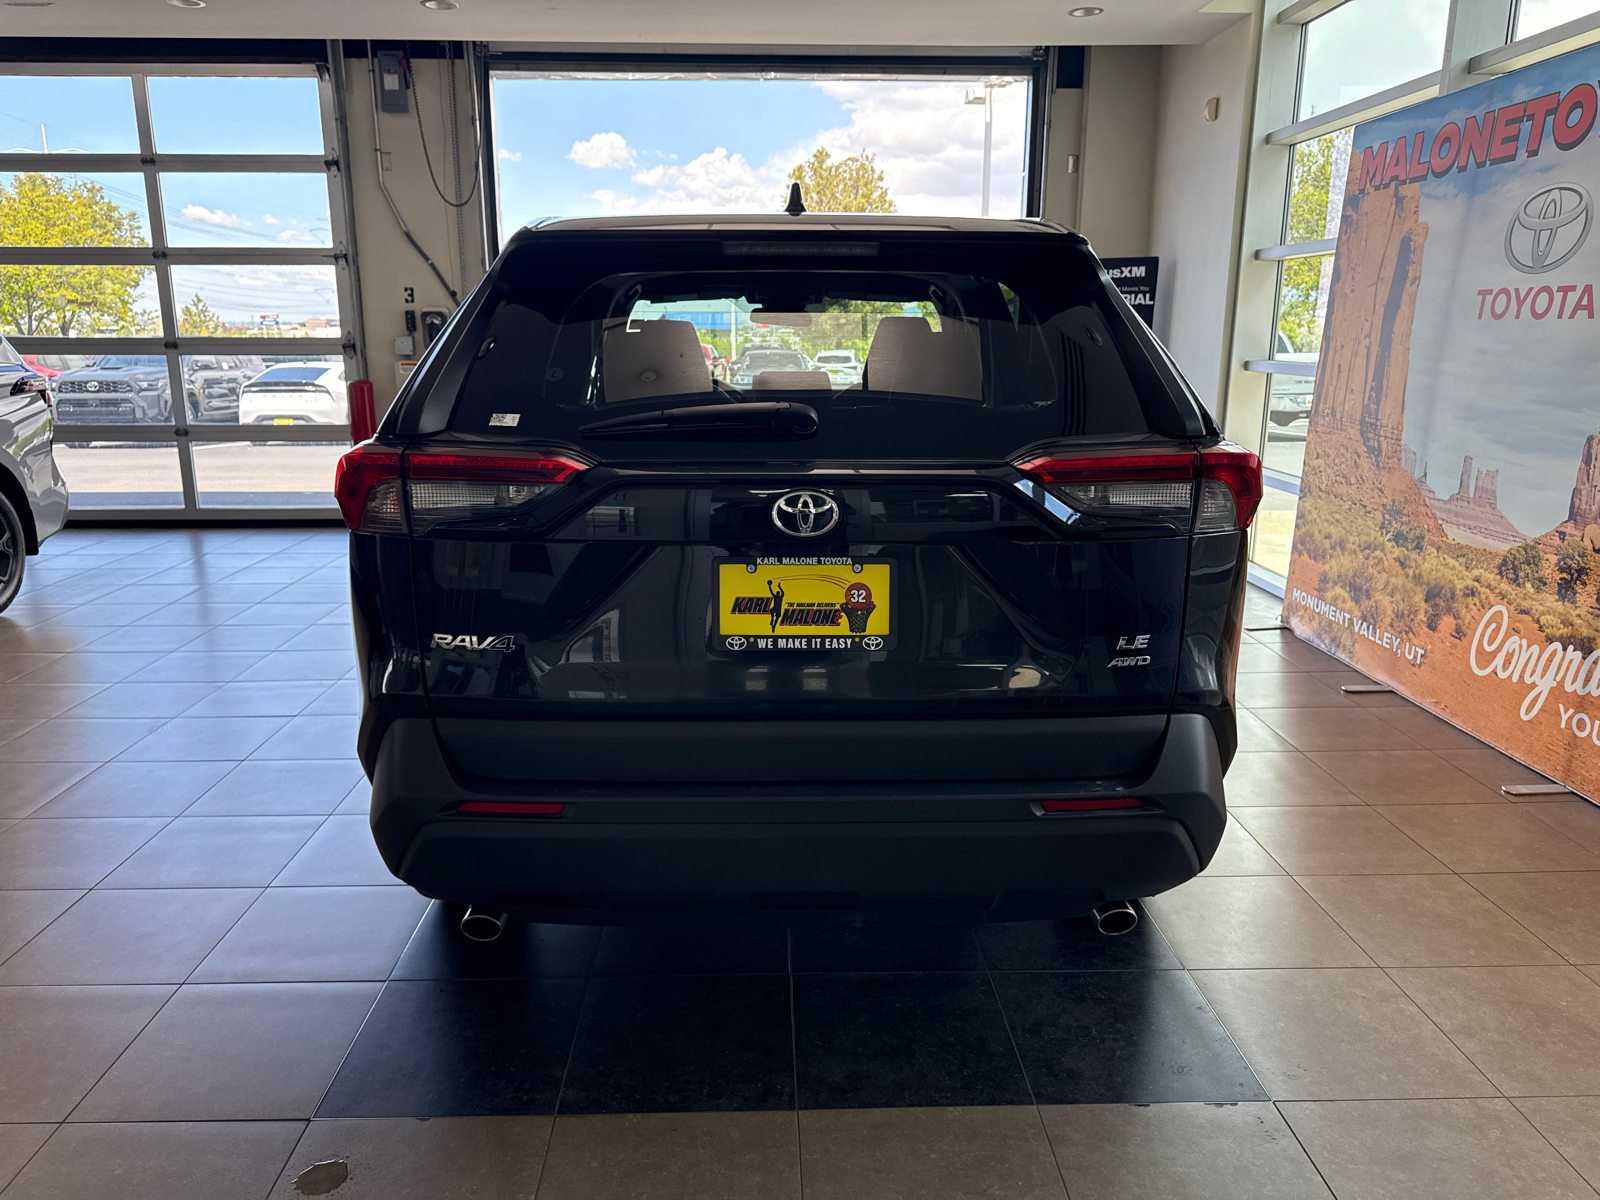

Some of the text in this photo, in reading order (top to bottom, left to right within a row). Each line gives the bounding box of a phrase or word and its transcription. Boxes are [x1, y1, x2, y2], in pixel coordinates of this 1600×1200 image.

[1358, 83, 1600, 193] MALONETO
[1105, 266, 1146, 278] usXM
[404, 287, 415, 304] 3
[1122, 294, 1153, 305] RIAL
[1476, 284, 1595, 321] TOYOTA
[756, 557, 853, 565] KARL MALONE TOYOTA
[850, 589, 866, 603] 32
[730, 596, 773, 614] KARL
[779, 608, 843, 626] MALONE
[1292, 587, 1426, 666] MONUMENT VALLEY, UT
[430, 633, 515, 653] RAV4
[757, 638, 852, 649] WE MAKE IT EASY
[1116, 635, 1151, 650] LE
[1106, 655, 1151, 668] AWD
